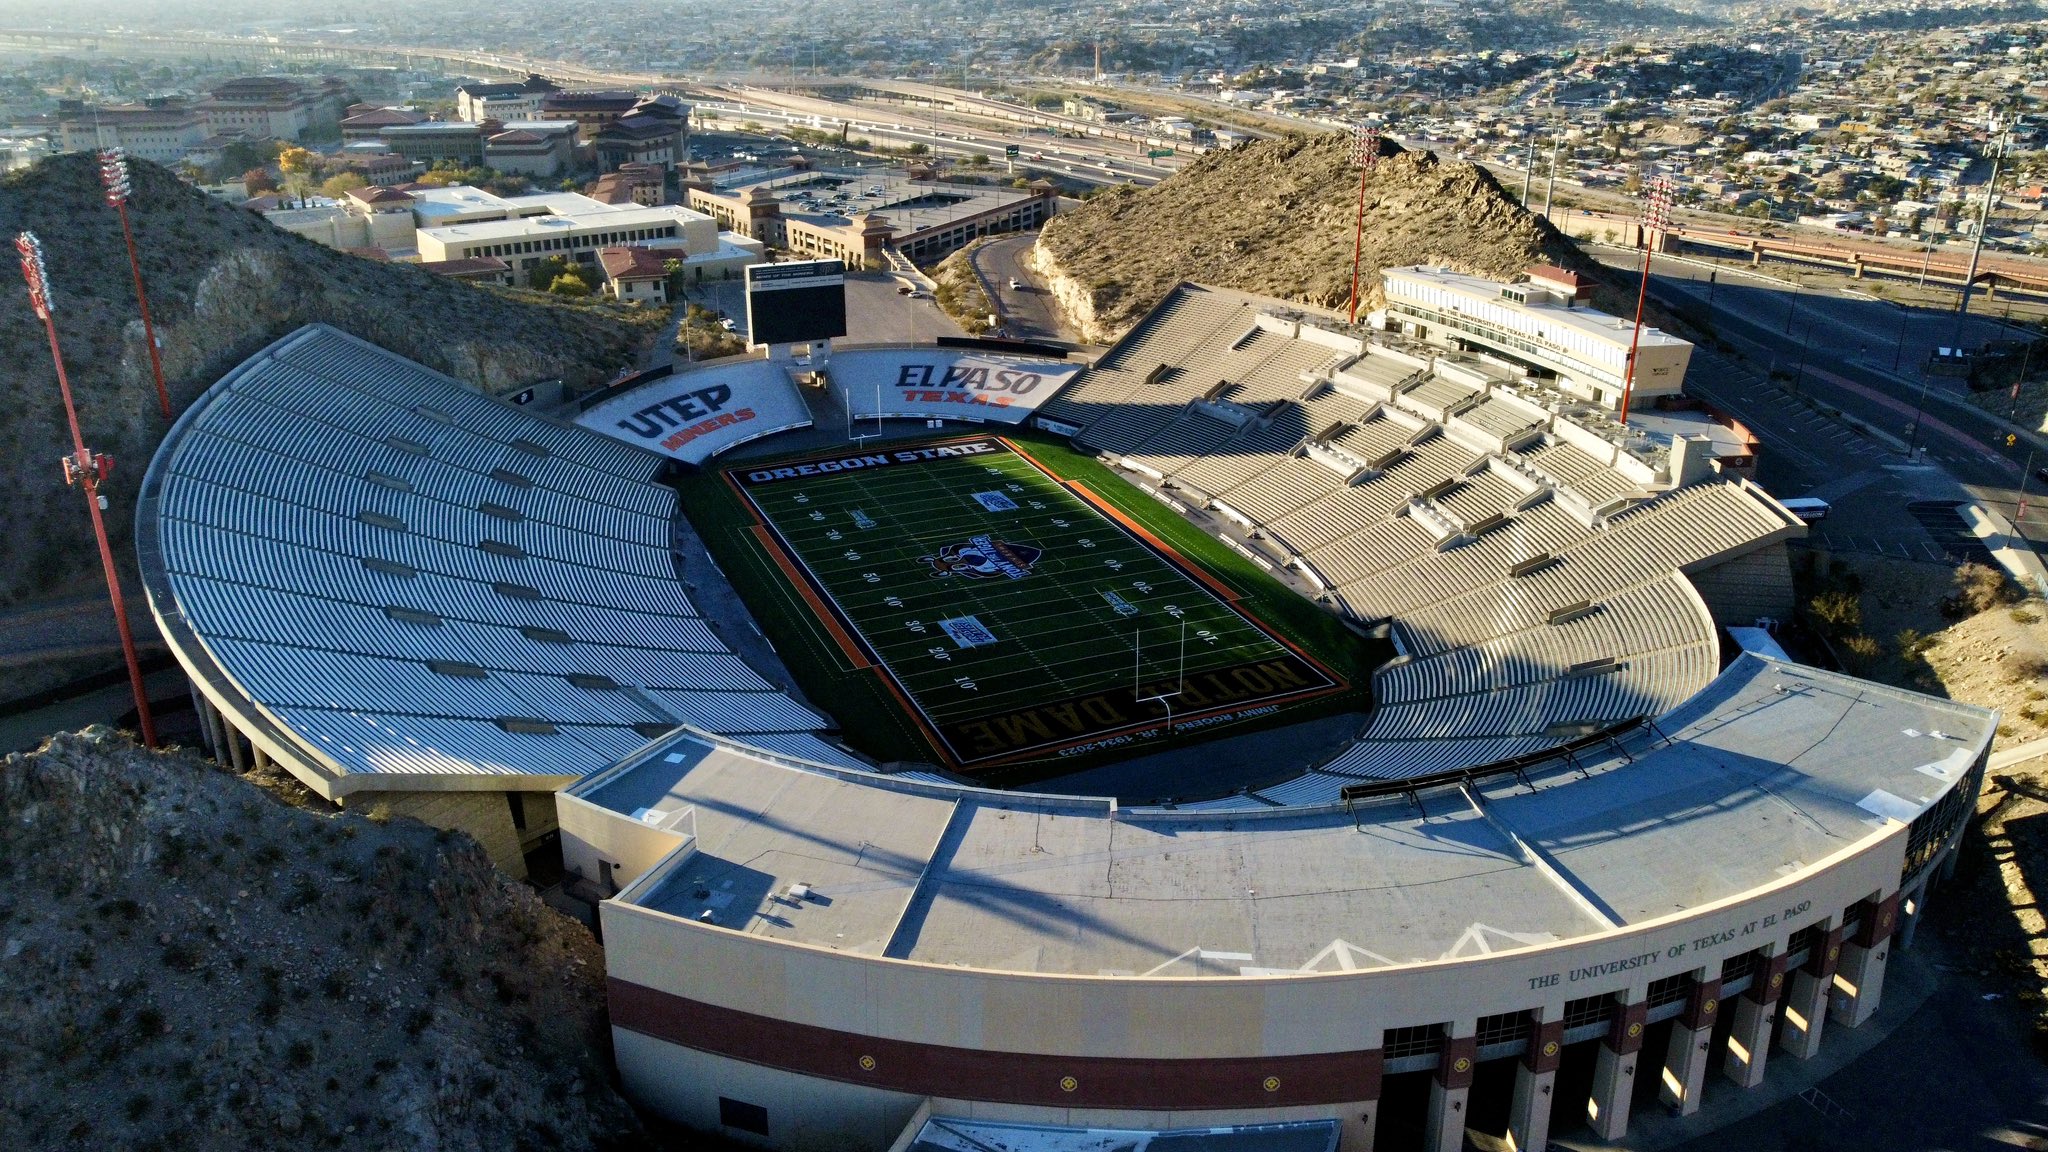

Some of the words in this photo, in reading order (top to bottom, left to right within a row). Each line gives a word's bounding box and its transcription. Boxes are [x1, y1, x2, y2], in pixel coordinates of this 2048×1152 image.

[1460, 313, 1496, 328] UNIVERSITY
[1507, 328, 1526, 338] TEXAS
[1545, 340, 1561, 350] PASO
[895, 365, 935, 387] EL
[938, 366, 1042, 395] PASO
[902, 390, 1016, 408] TEXAS
[616, 384, 732, 439] UTEP
[660, 407, 756, 452] MINERS
[748, 454, 889, 482] OREGON
[893, 442, 995, 462] STATE
[808, 512, 826, 520] 20
[1050, 519, 1071, 527] 40
[825, 531, 843, 539] 30
[972, 538, 998, 554] TIGER
[1076, 539, 1097, 547] 50
[843, 551, 862, 559] 40
[995, 561, 1026, 577] TONY
[1102, 559, 1125, 568] 40
[862, 572, 881, 581] 50
[1131, 581, 1154, 590] 30
[883, 596, 902, 605] 40
[1161, 605, 1186, 614] 20
[905, 620, 926, 631] 30
[1194, 630, 1220, 641] 10
[928, 647, 950, 658] 20
[953, 676, 977, 688] 10
[1235, 704, 1280, 718] JIMMY
[957, 695, 1127, 754] DAME
[1529, 973, 1560, 990] THE
[1569, 950, 1661, 982] UNIVERSITY
[1667, 943, 1687, 959] OF
[1692, 928, 1735, 952] TEXAS
[1740, 921, 1759, 937] AT
[1761, 913, 1779, 930] EL
[1781, 899, 1812, 921] PASO
